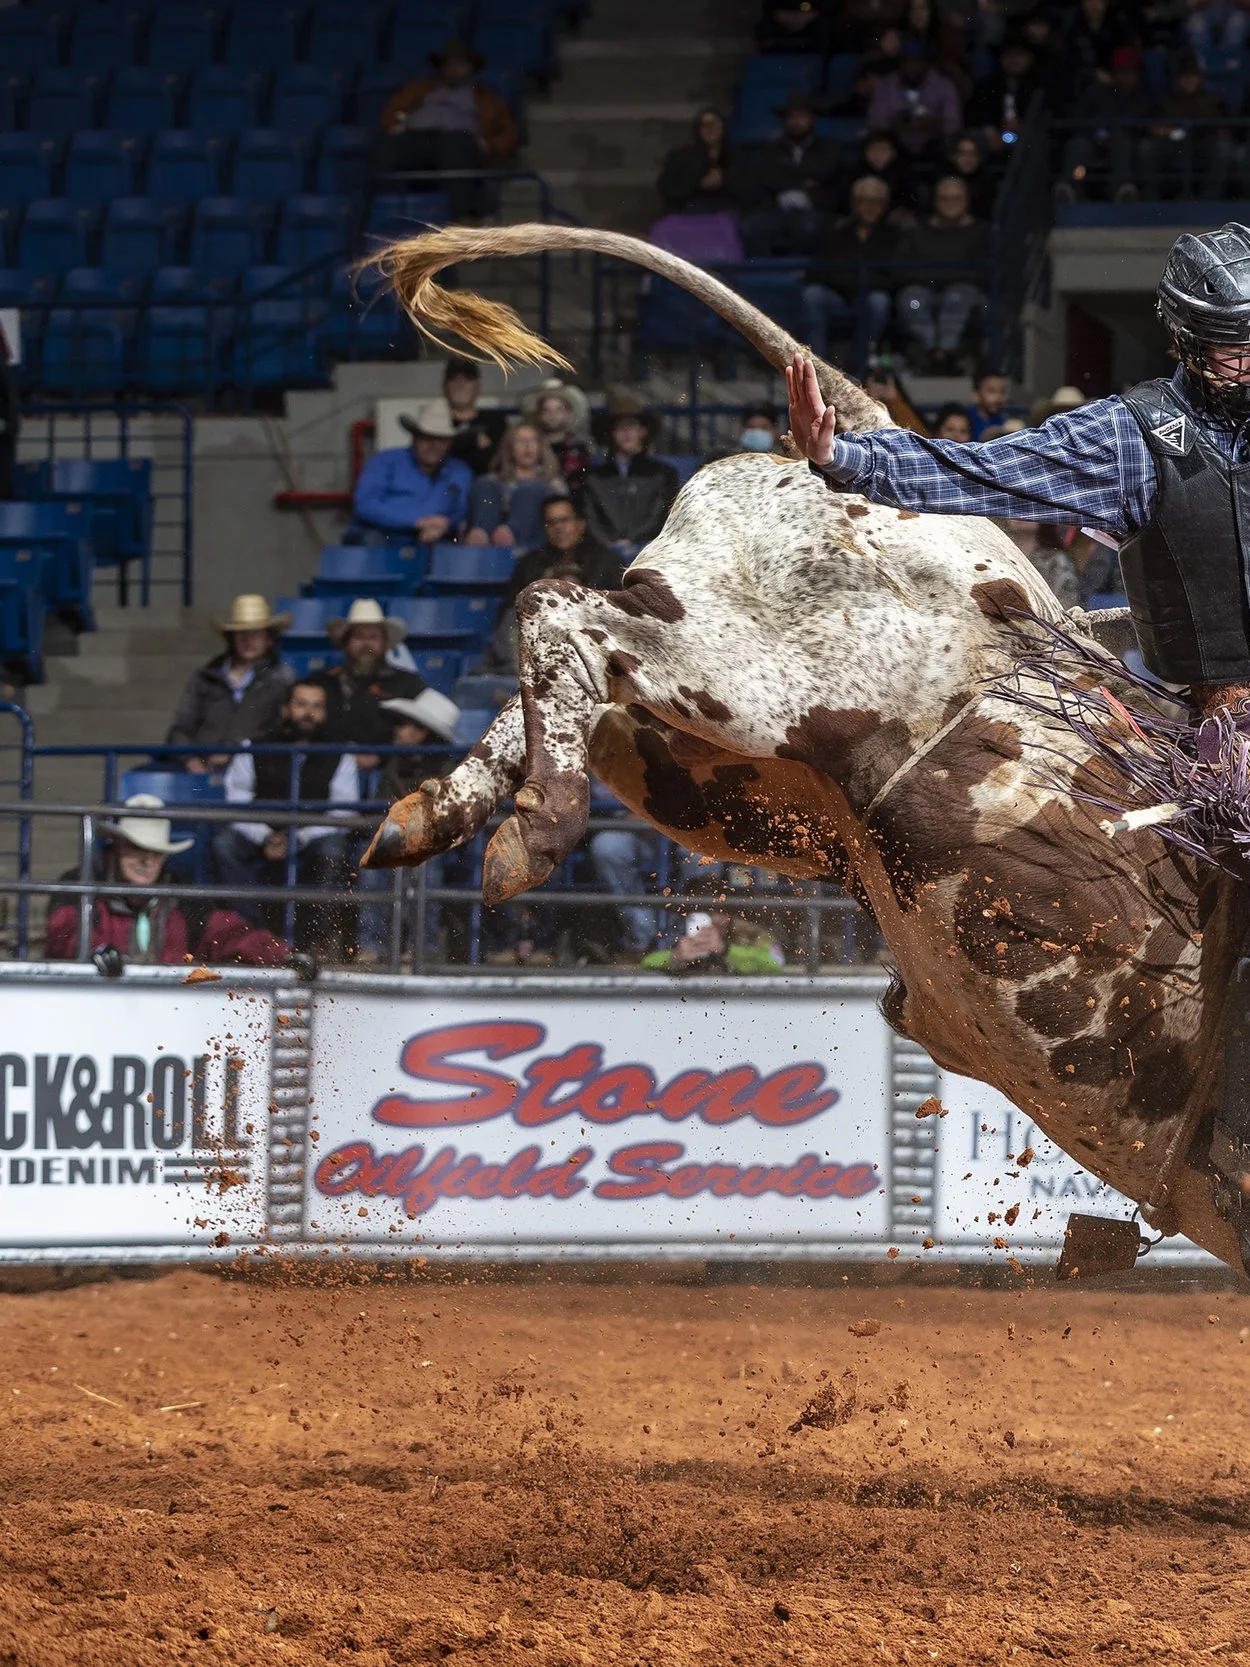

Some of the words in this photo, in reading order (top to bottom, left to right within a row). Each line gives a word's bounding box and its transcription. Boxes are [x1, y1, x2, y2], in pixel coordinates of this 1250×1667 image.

[371, 1017, 841, 1128] Stone
[9, 1157, 155, 1185] DENIM
[313, 1141, 595, 1216] Oilfield
[594, 1140, 881, 1200] Service
